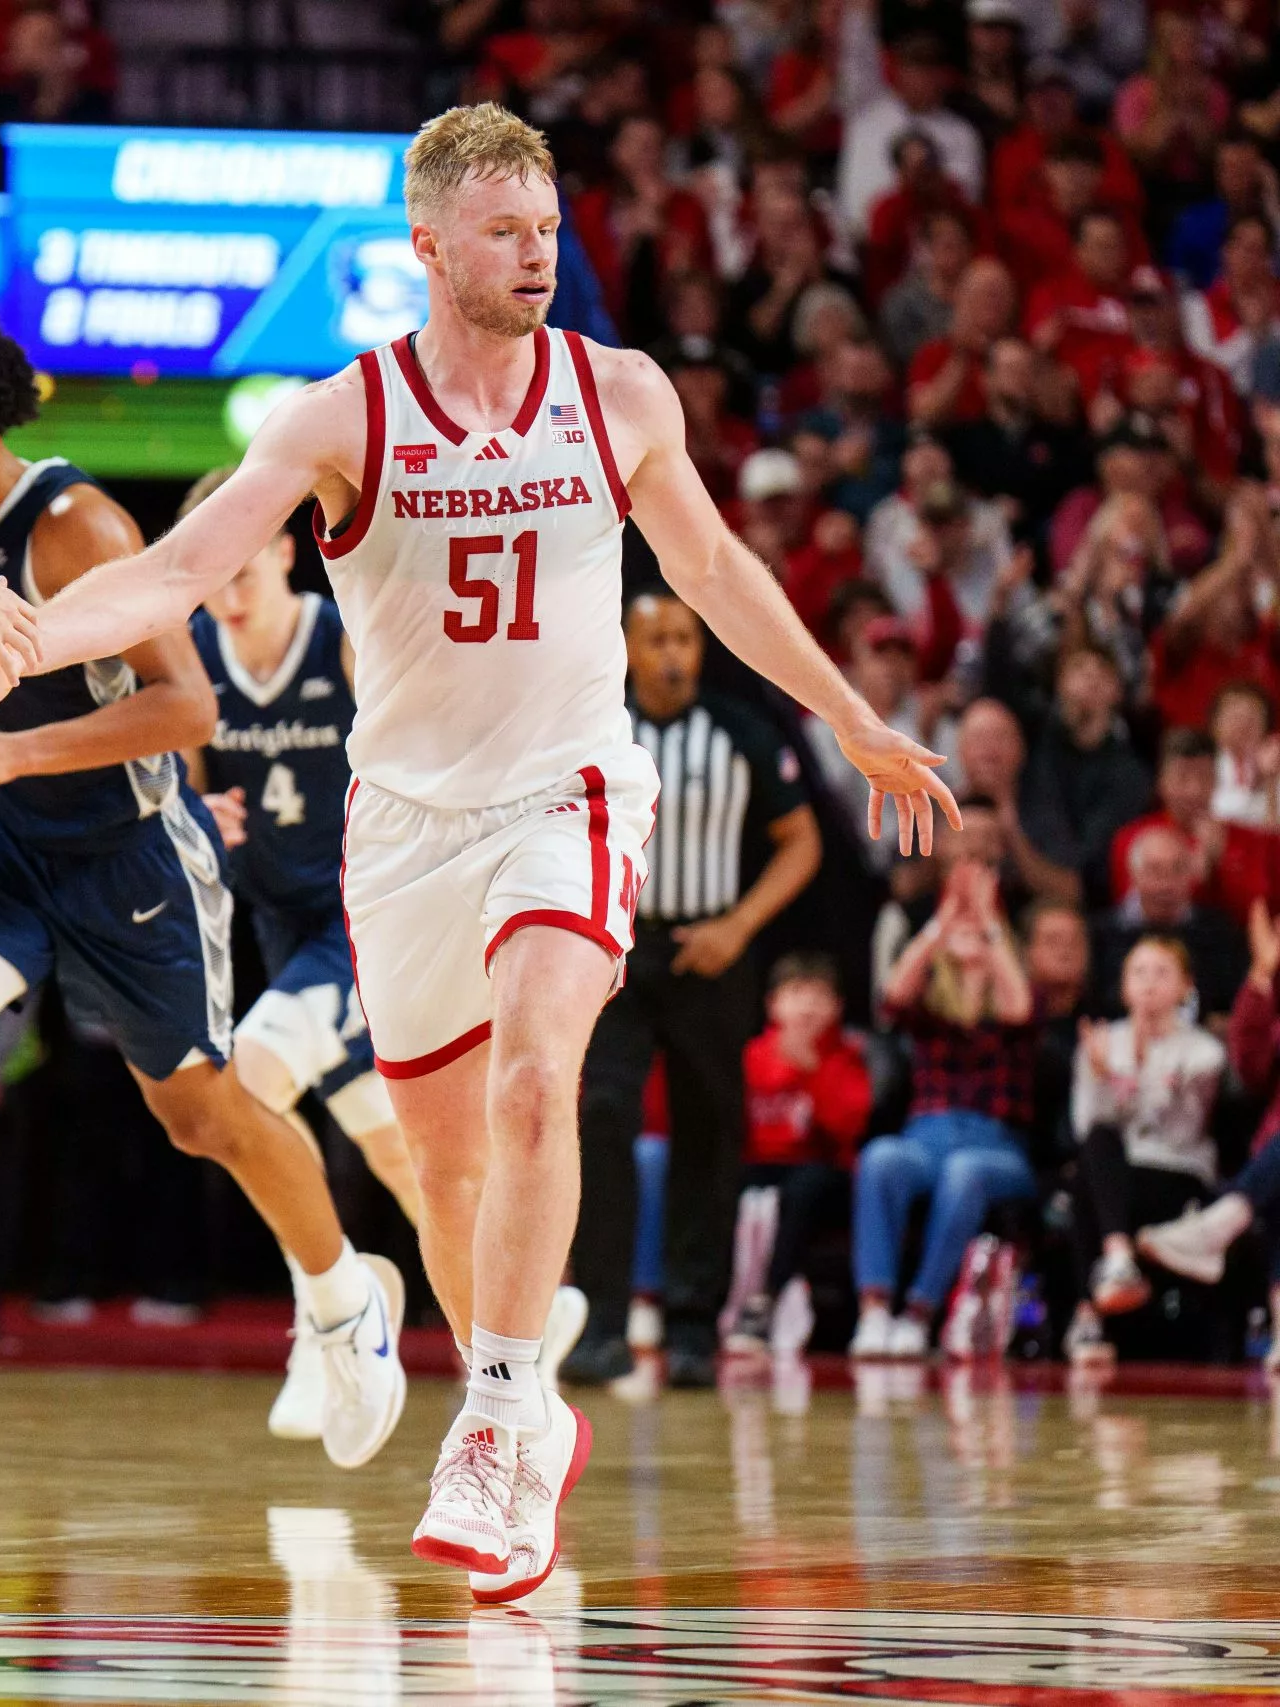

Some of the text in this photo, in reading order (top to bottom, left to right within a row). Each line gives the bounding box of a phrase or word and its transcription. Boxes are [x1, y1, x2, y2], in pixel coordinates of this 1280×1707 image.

[395, 448, 435, 457] GRADUATE
[392, 476, 593, 519] NEBRASKA
[443, 530, 539, 643] 51
[261, 763, 305, 827] 4
